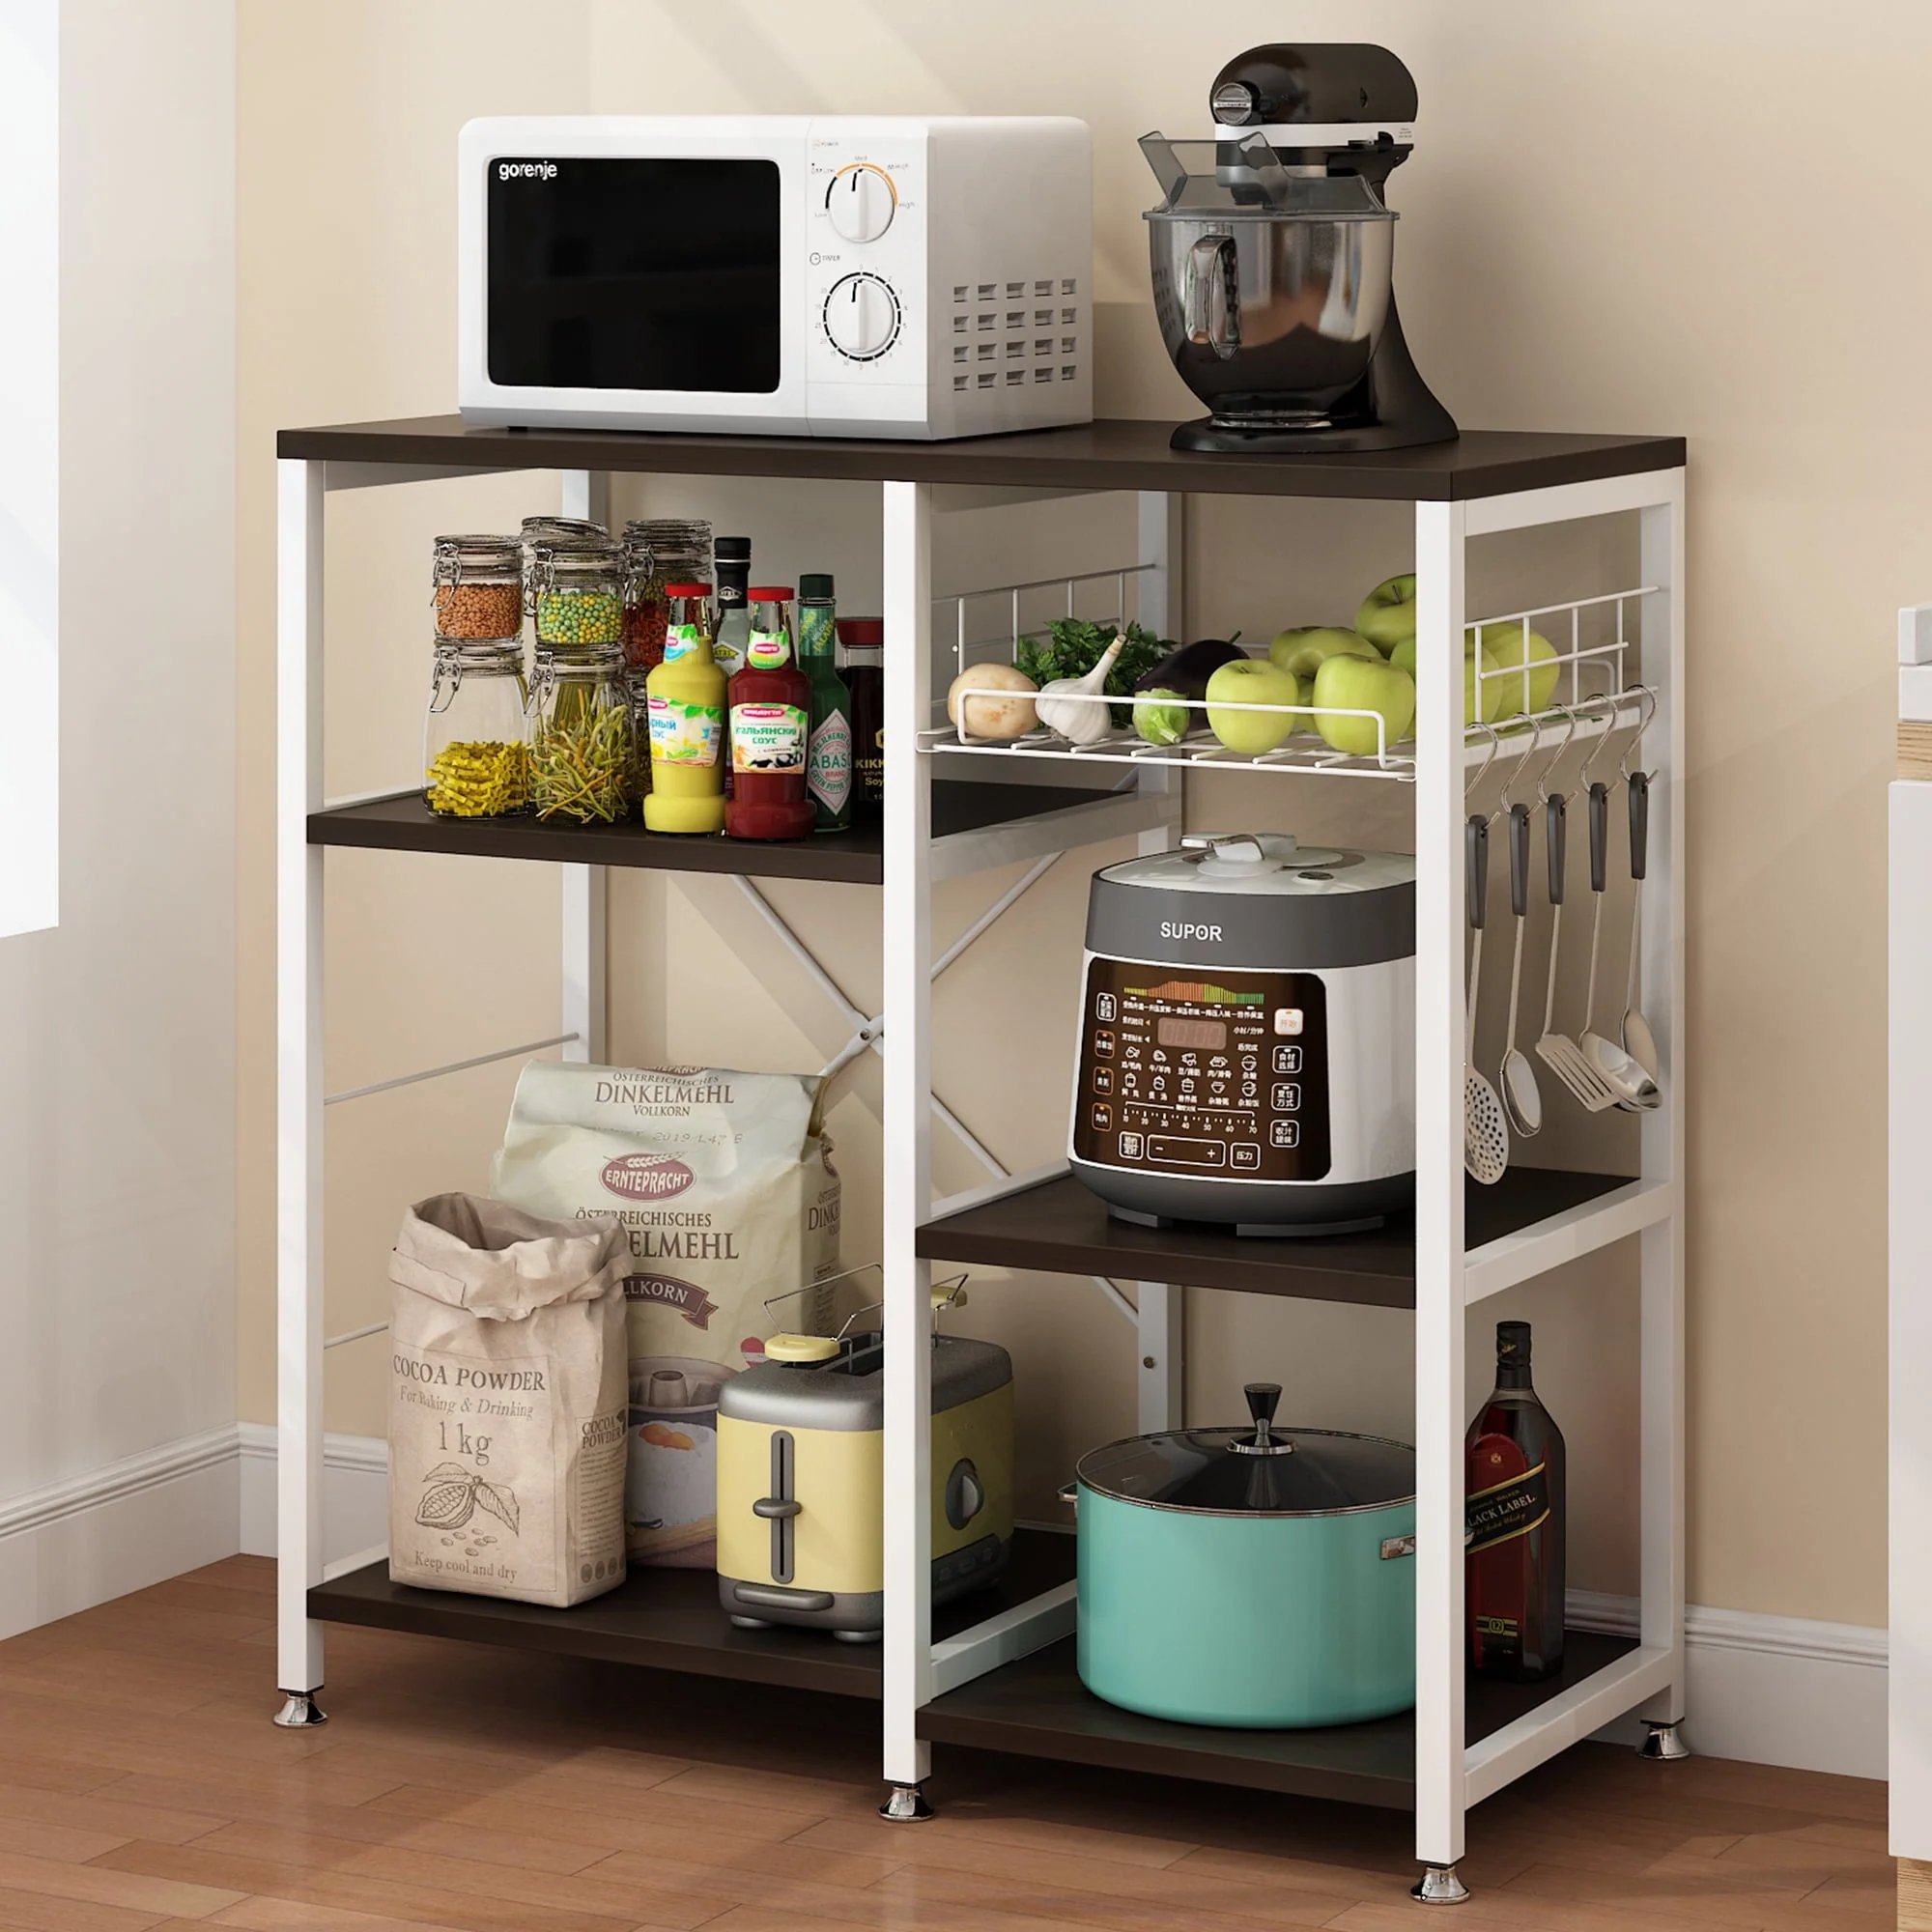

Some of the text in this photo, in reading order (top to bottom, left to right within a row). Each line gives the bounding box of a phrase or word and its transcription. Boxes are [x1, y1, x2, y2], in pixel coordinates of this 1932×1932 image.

[498, 159, 558, 181] gorenje
[810, 754, 851, 769] ABAS
[1160, 922, 1223, 942] SUPOR
[612, 1071, 720, 1087] ÖSTERREICHISCHES
[595, 1081, 734, 1103] DINKELMEHL
[633, 1104, 691, 1117] VOLLKORN
[1141, 1117, 1150, 1125] 20
[1160, 1120, 1169, 1128] 30
[1181, 1122, 1190, 1130] 40
[1225, 1124, 1235, 1133] 60
[1236, 1151, 1254, 1160] 压力
[605, 1169, 690, 1194] ERNTEPRACHT
[628, 1230, 740, 1260] ELMEHL
[393, 1354, 546, 1391] COCOA POWDER
[400, 1384, 533, 1422] For Baking & Drinking
[438, 1420, 493, 1466] 1 kg
[582, 1430, 623, 1449] POWDER
[1468, 1507, 1498, 1527] LACK
[1497, 1493, 1537, 1516] LABEL
[414, 1549, 518, 1583] Keep cool and dry
